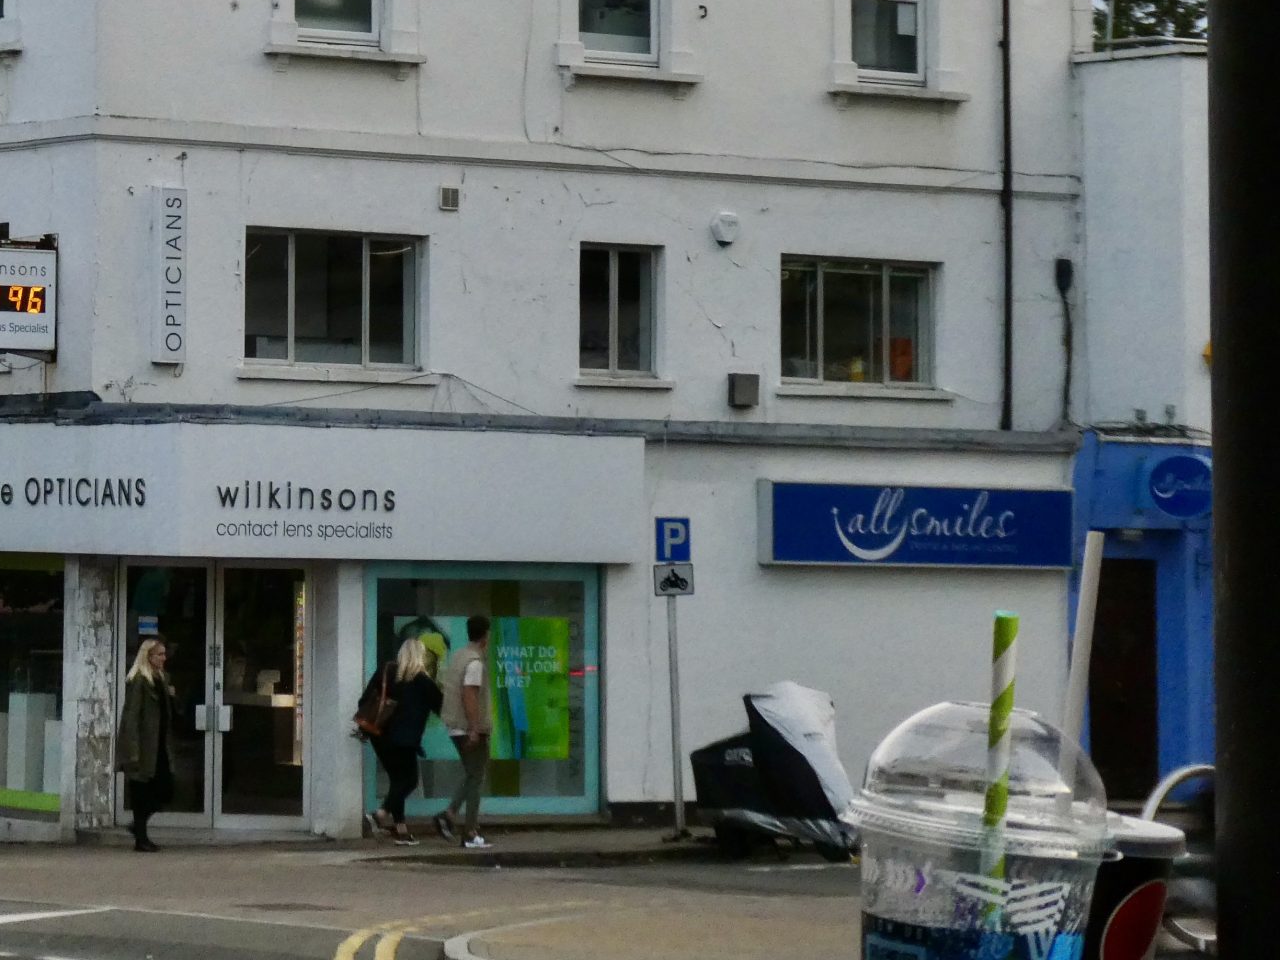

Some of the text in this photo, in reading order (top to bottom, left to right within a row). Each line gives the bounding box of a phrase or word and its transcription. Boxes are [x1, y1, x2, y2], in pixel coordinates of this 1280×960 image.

[165, 196, 182, 352] OPTICIANS
[9, 322, 48, 334] Specialist
[24, 477, 146, 507] OPTICIANS
[217, 480, 396, 512] wilkinsons
[910, 490, 1017, 538] smiles
[216, 520, 393, 540] contact lens specialists
[663, 522, 686, 558] P
[497, 646, 557, 657] WHAT DO
